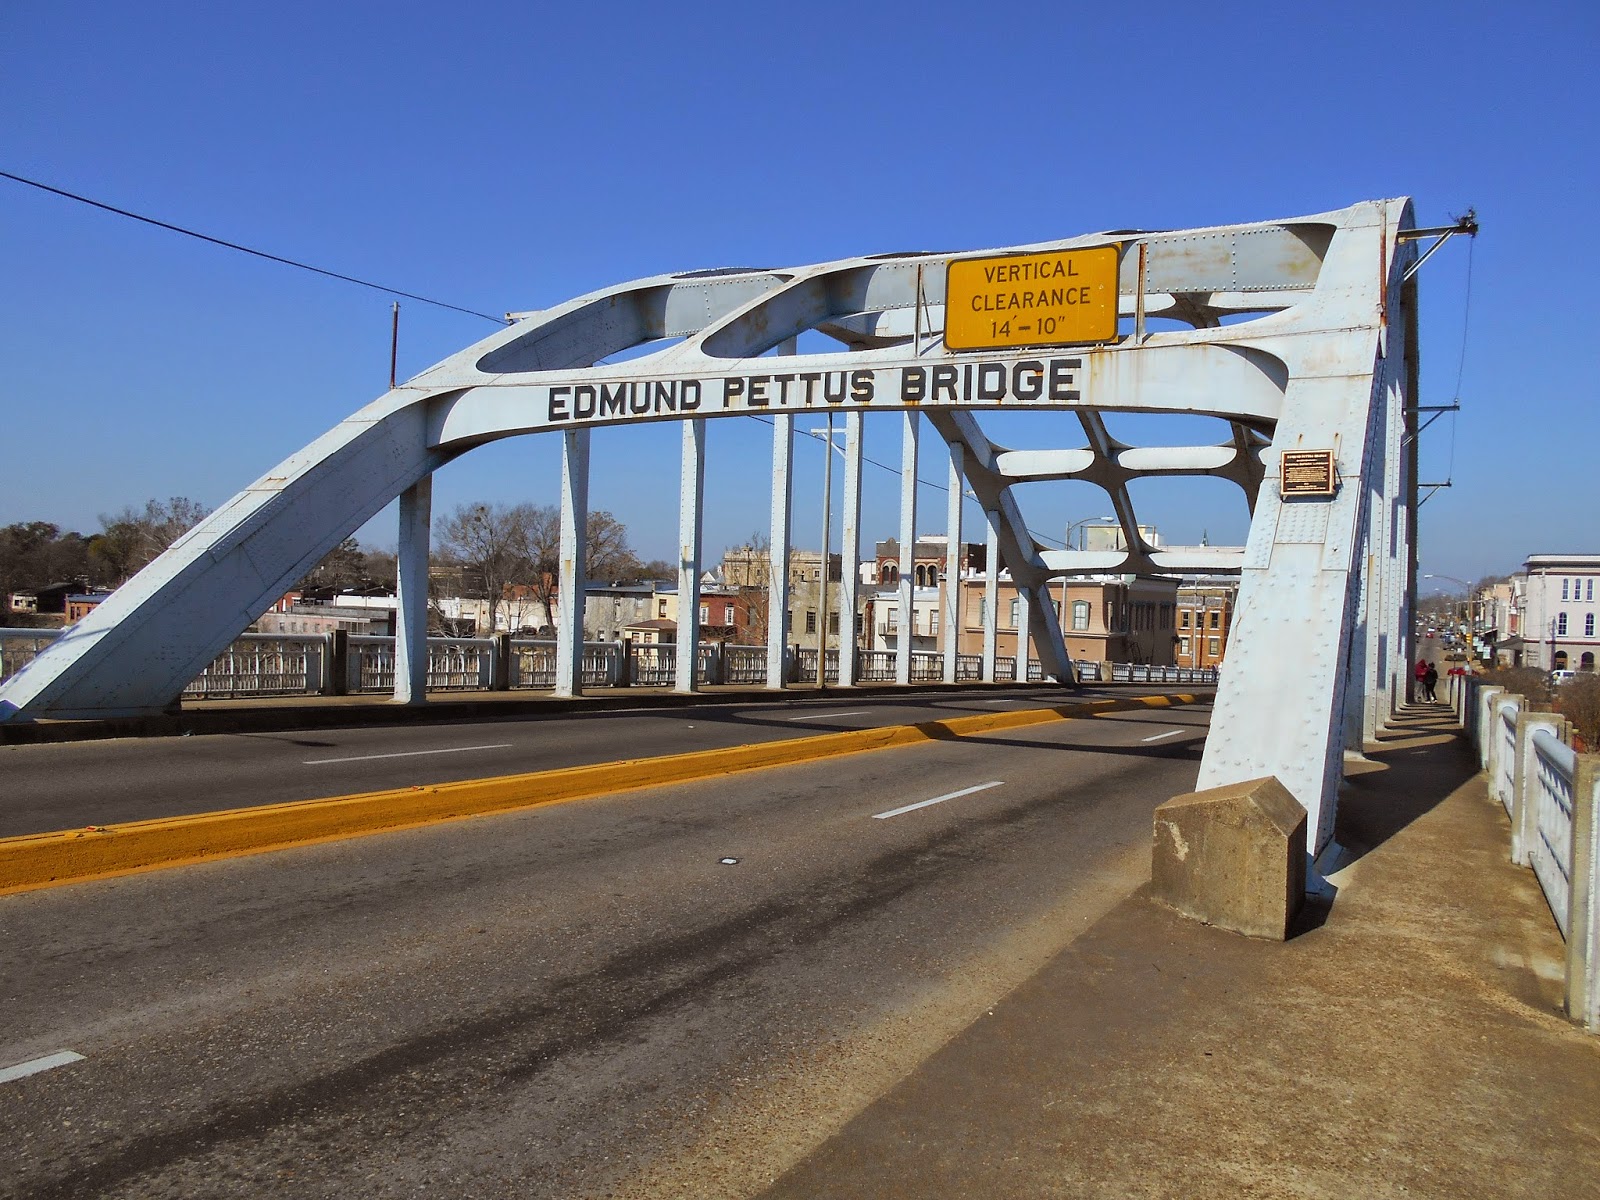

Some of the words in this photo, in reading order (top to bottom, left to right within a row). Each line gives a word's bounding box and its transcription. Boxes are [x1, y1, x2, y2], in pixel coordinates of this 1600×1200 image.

[984, 259, 1079, 283] VERTICAL
[971, 287, 1091, 312] CLEARANCE
[548, 379, 702, 422] EDMUND
[722, 369, 875, 408] PETTUS
[900, 358, 1083, 401] BRIDGE
